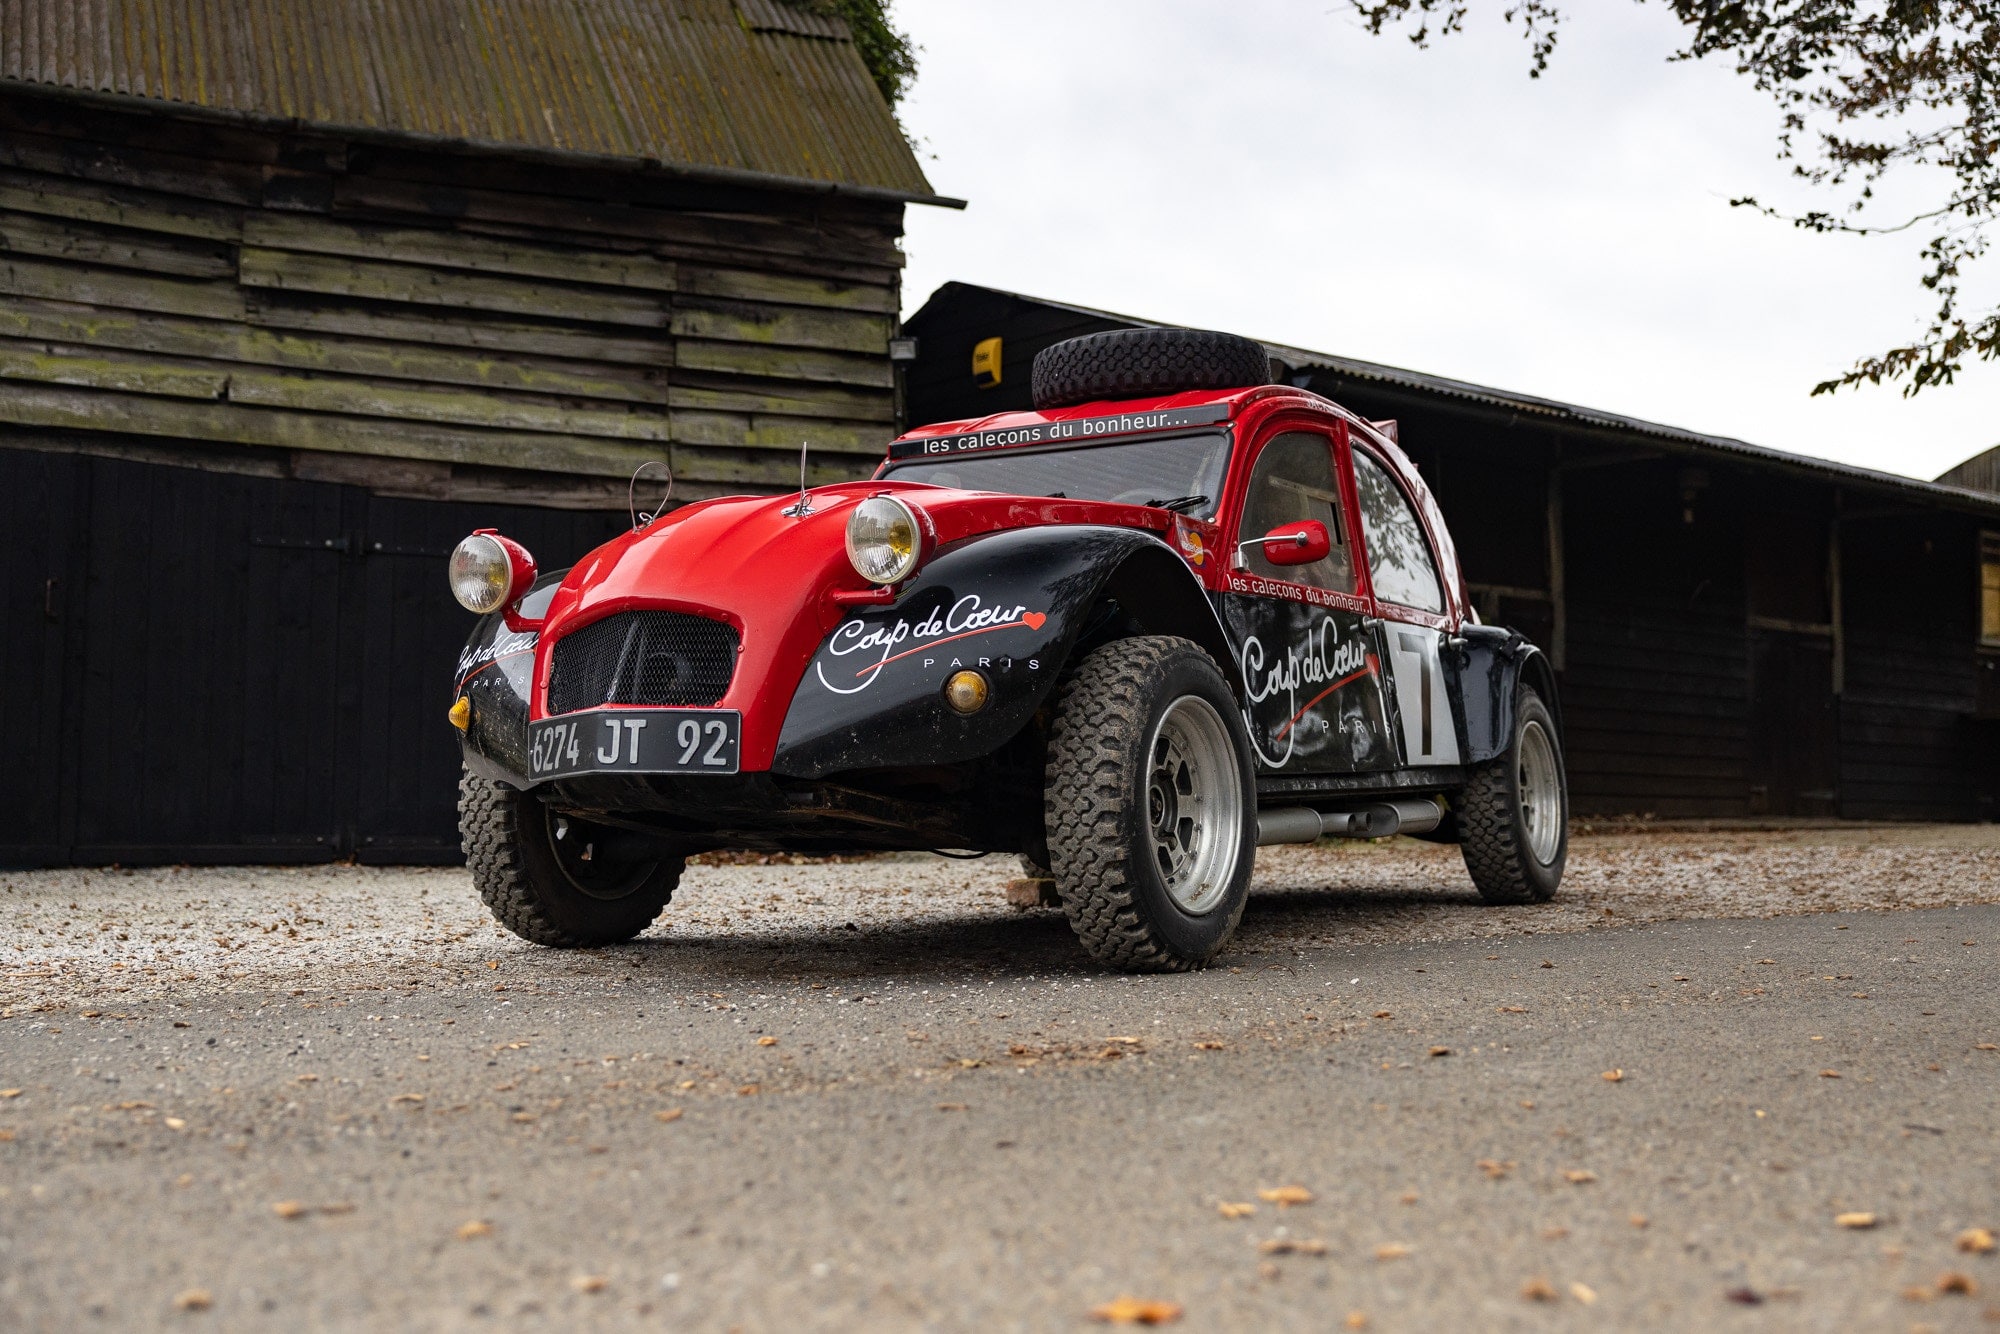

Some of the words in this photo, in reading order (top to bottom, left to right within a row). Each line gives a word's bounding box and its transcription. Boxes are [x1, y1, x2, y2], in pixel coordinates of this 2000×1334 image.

[924, 438, 950, 454] les
[957, 427, 1041, 447] caleçons
[1049, 422, 1073, 439] du
[1083, 413, 1188, 435] bonheur...
[1226, 573, 1248, 592] les
[1251, 579, 1303, 600] caleçons
[1305, 587, 1320, 603] du
[913, 605, 944, 638] de
[924, 656, 1040, 670] PARIS
[1302, 628, 1324, 684] de
[473, 675, 525, 689] PARIS
[1397, 631, 1433, 756] 7
[1321, 719, 1391, 735] PARIS
[533, 722, 580, 773] 6274
[597, 719, 647, 764] JT
[677, 719, 728, 766] 92
